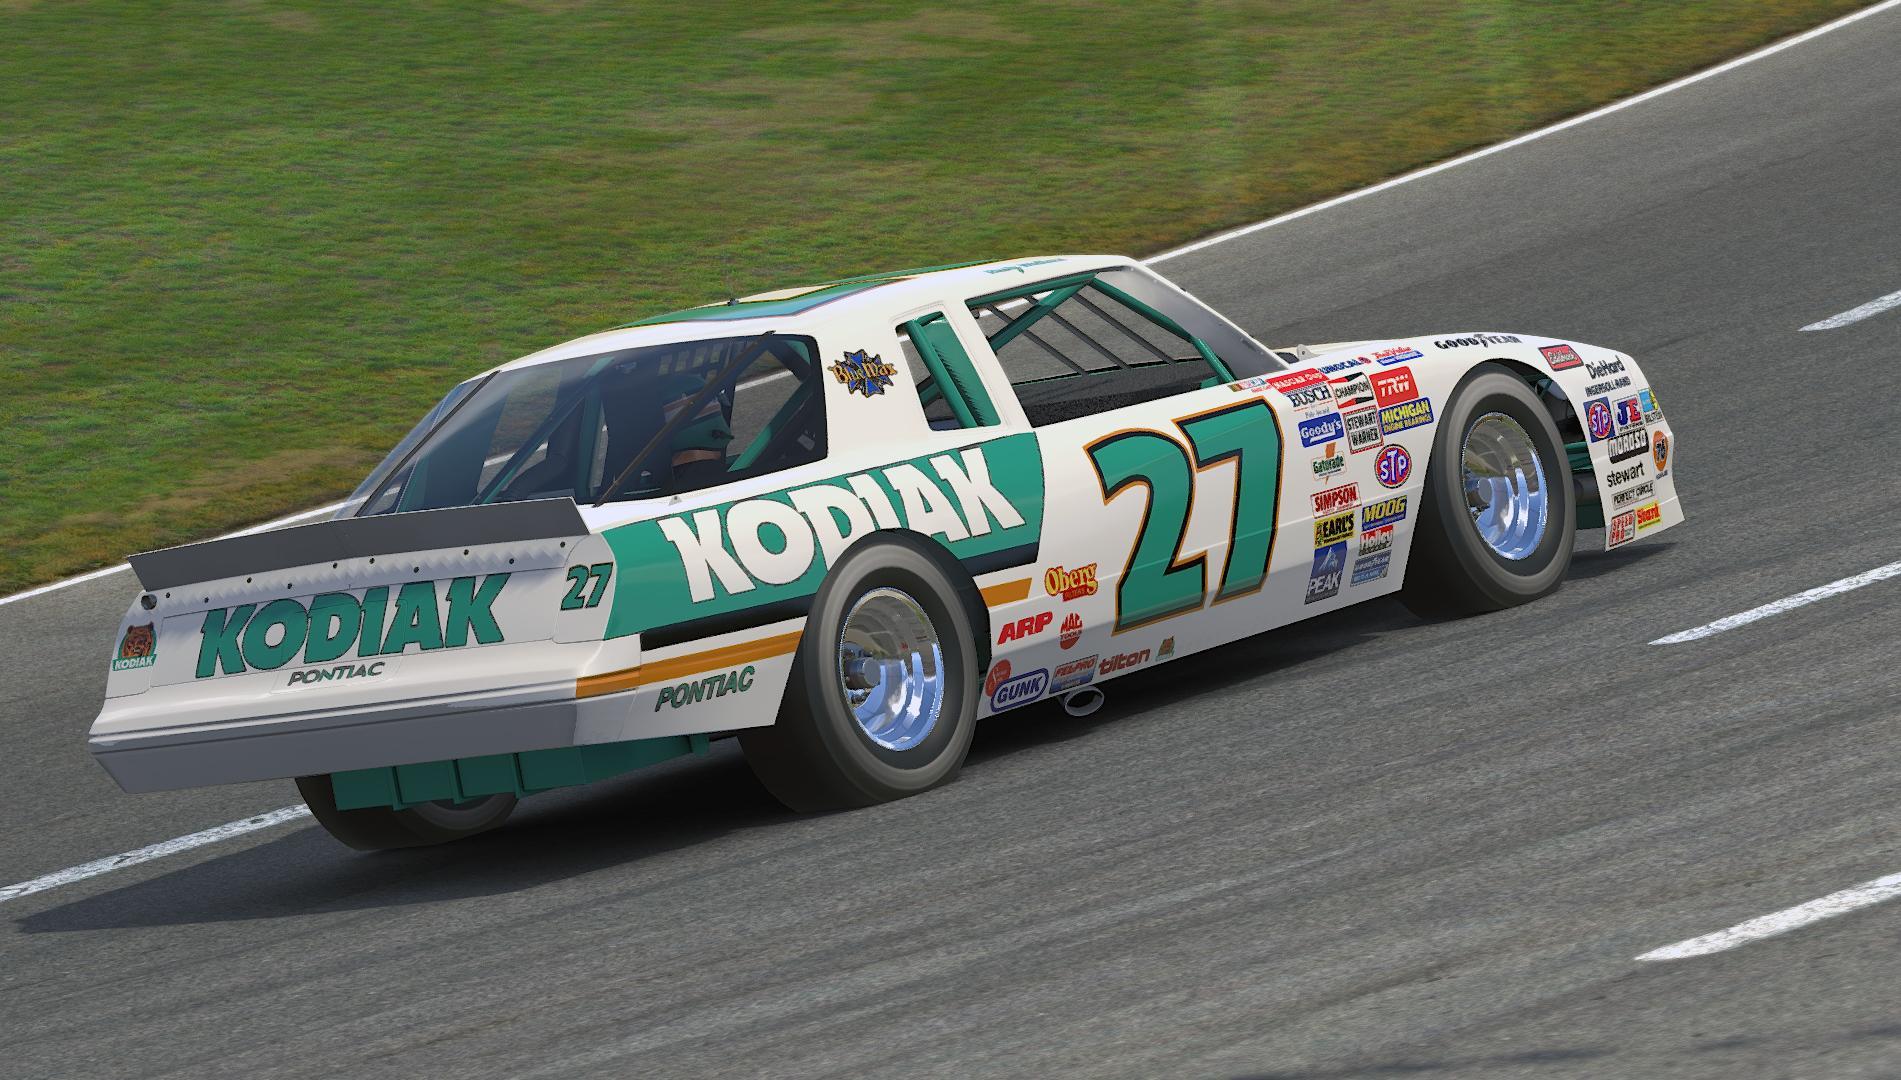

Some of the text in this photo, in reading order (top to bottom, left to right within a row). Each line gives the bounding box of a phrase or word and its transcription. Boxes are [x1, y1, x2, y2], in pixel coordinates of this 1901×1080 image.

[1434, 333, 1522, 349] GOODYEAR
[1585, 355, 1625, 379] DieHard
[1287, 385, 1332, 408] BUSCH
[1335, 381, 1371, 399] CHAMPION
[1377, 373, 1410, 398] TRW
[1347, 412, 1377, 431] STEWART
[1381, 400, 1430, 423] MICHIGAN
[1591, 406, 1609, 435] STP
[1617, 397, 1641, 426] JE
[1300, 419, 1342, 439] Goody's
[1350, 427, 1379, 446] WARNER
[1313, 455, 1345, 474] Gatorade
[1380, 448, 1408, 482] STP
[1607, 461, 1645, 487] stewart
[1314, 485, 1358, 513] SIMPSON
[1614, 482, 1654, 504] PERFECT CIRCLE
[1083, 396, 1284, 637] 27
[1364, 497, 1407, 522] MOOG
[656, 446, 1026, 604] KODIAK
[1360, 528, 1393, 552] Holley
[560, 562, 614, 611] 27
[1044, 563, 1098, 596] Oberg
[1308, 571, 1341, 595] PEAK
[195, 572, 511, 679] KODIAK
[997, 611, 1054, 645] ARP
[1060, 612, 1083, 633] MAC
[1060, 629, 1083, 641] TOOLS
[114, 655, 154, 671] KODIAK
[287, 661, 387, 688] PONTIAC
[1099, 648, 1151, 676] tilton
[655, 665, 756, 712] PONTIAC
[997, 675, 1043, 704] GUNK
